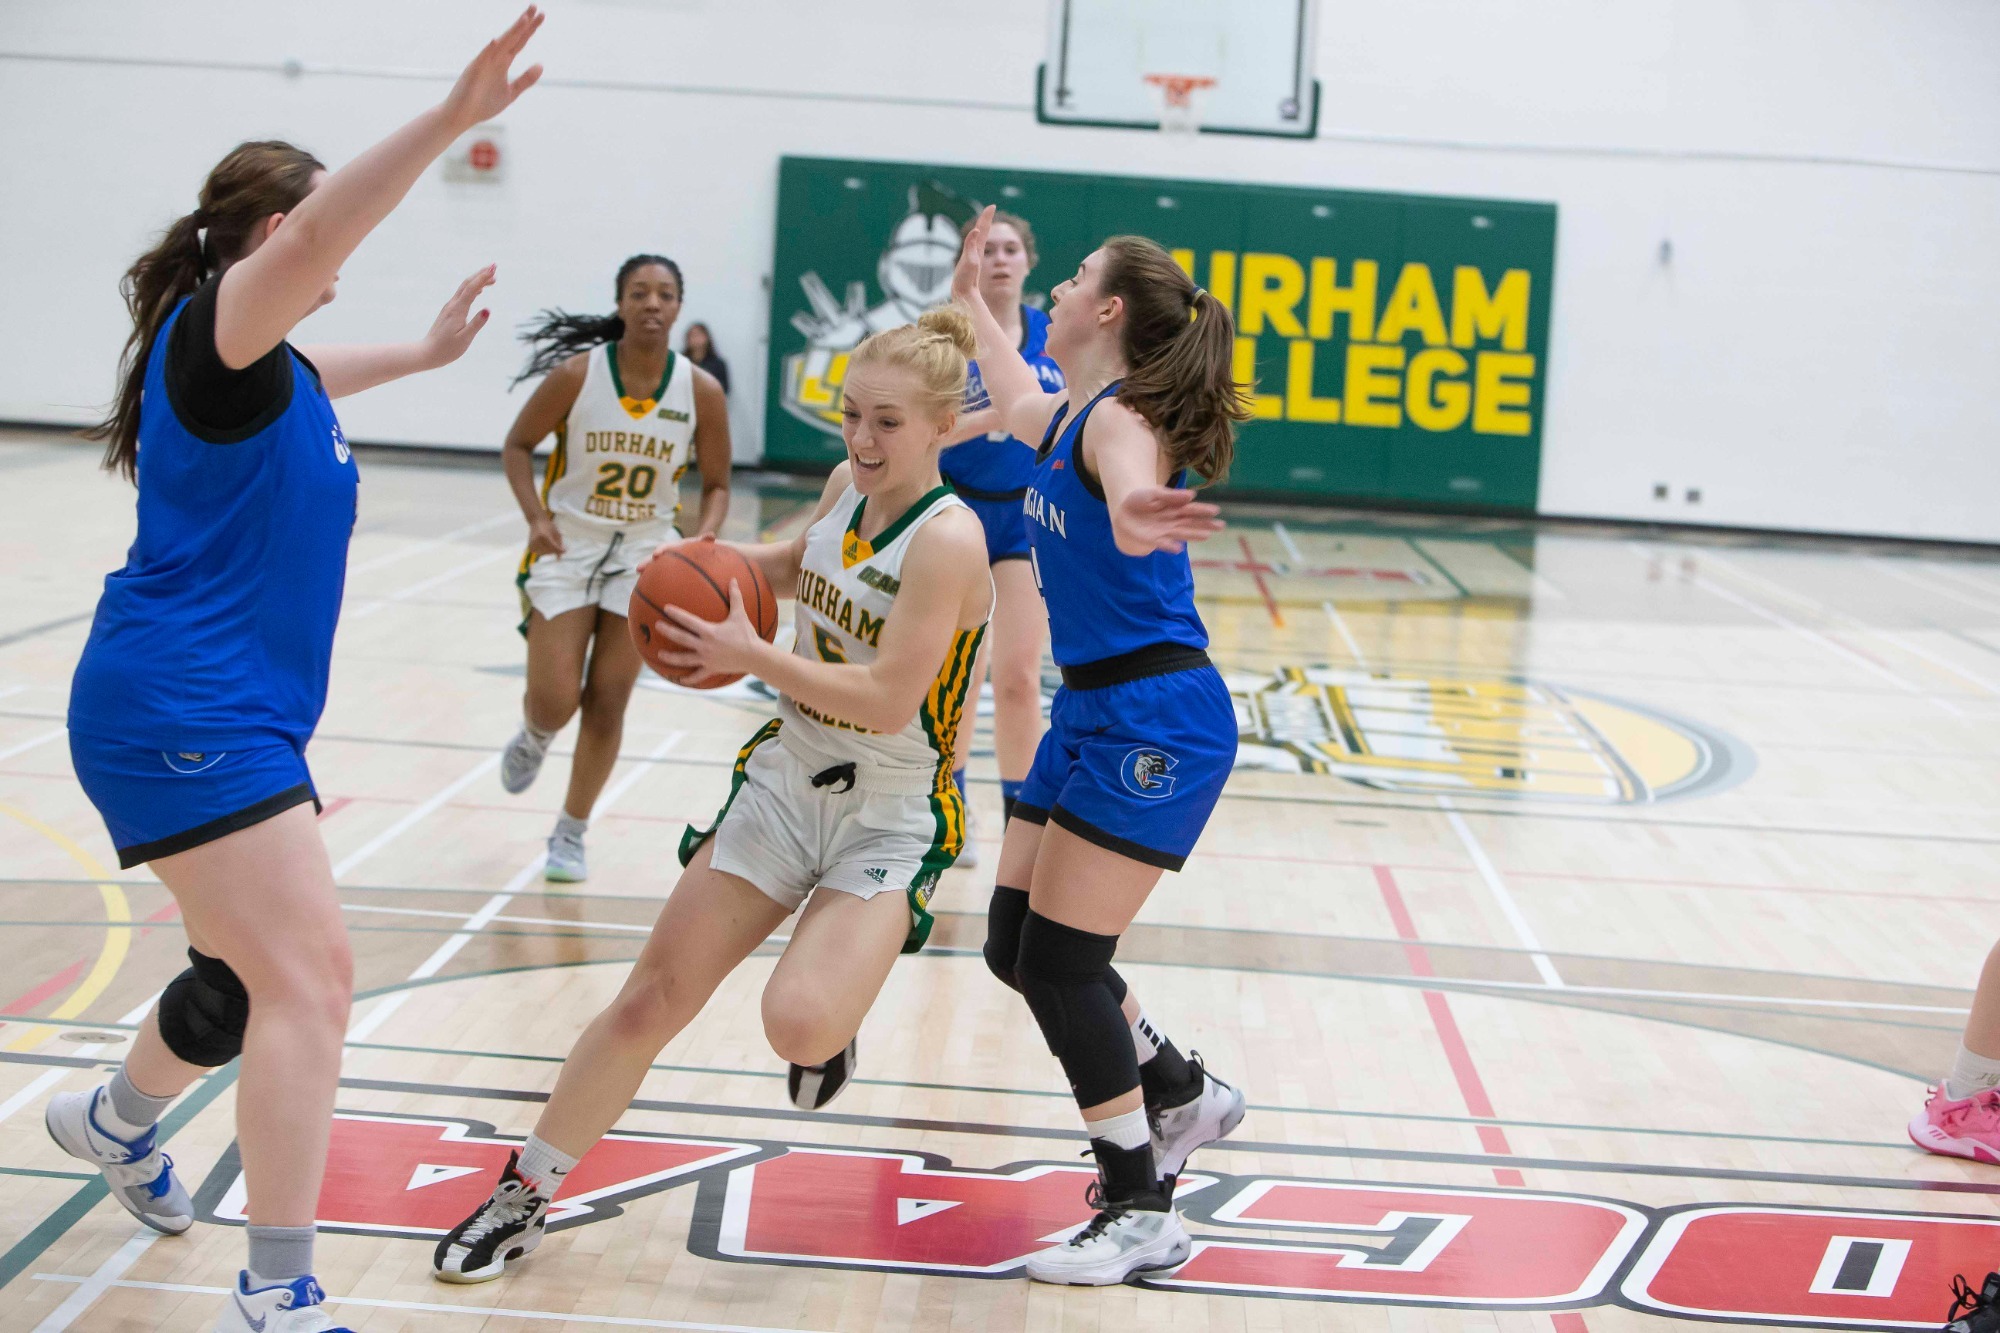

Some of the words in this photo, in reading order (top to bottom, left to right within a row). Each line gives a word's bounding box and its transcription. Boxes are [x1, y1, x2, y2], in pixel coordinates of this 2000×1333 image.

[1169, 248, 1532, 351] RHAM
[1223, 336, 1536, 436] LLEGE
[585, 431, 675, 463] DURHAM
[595, 462, 657, 500] 20
